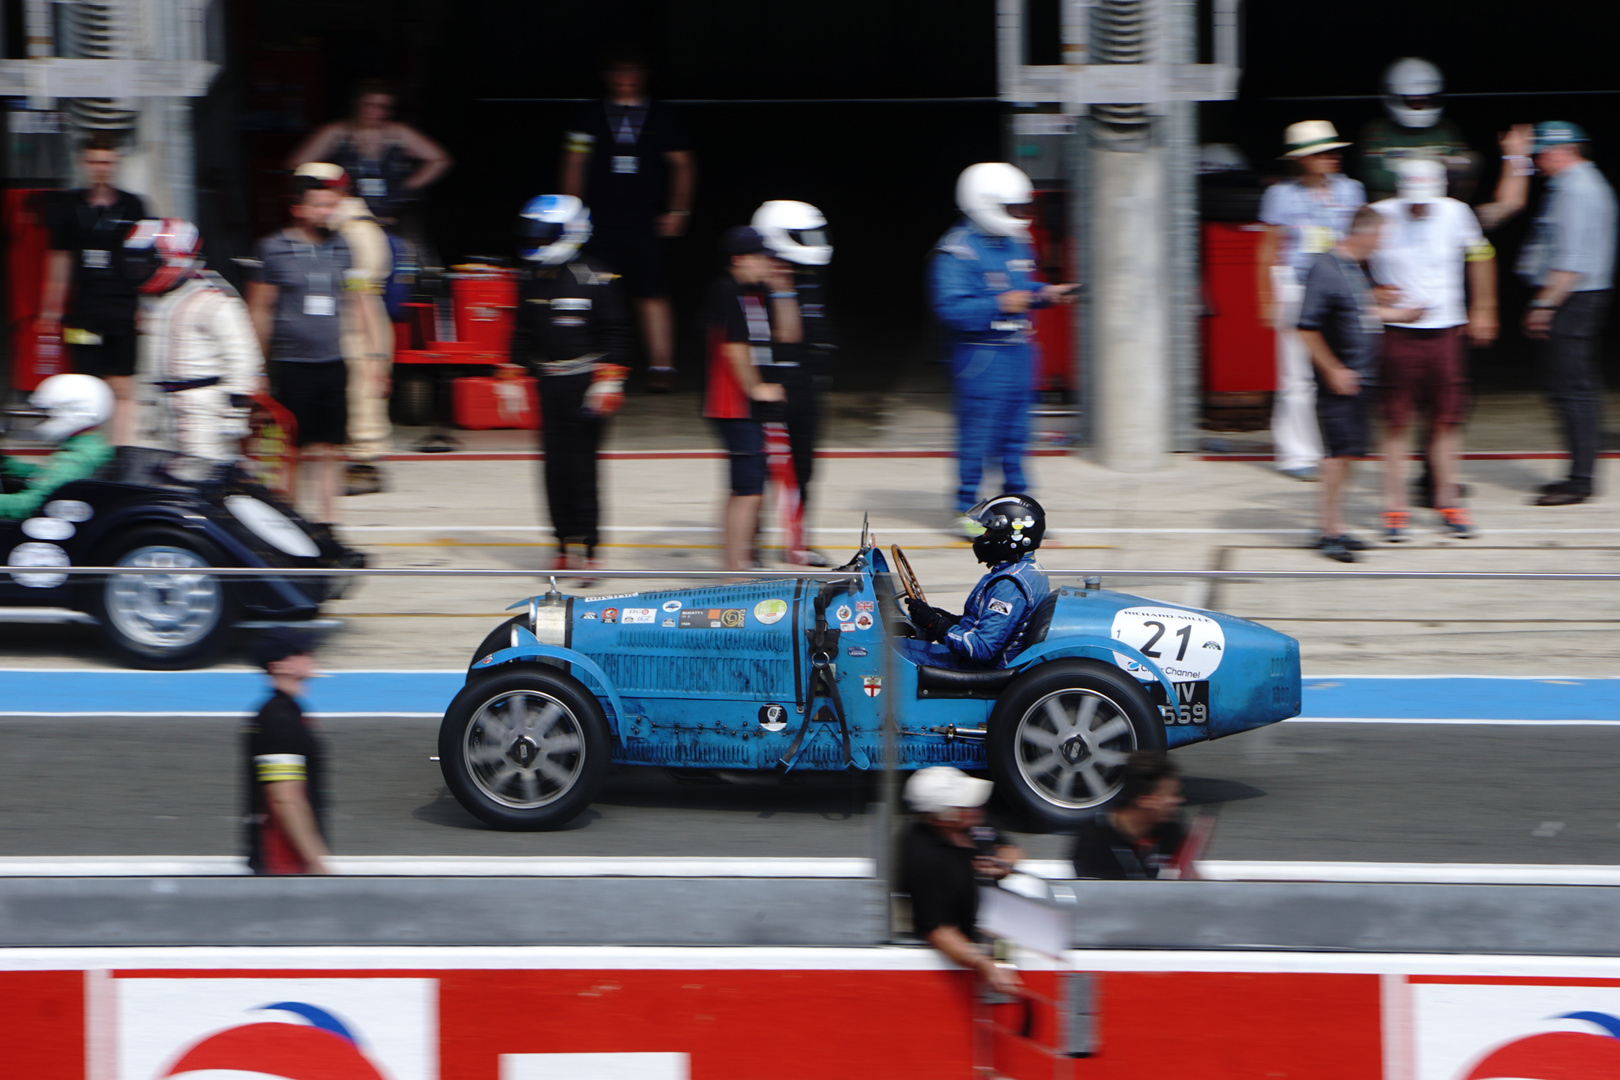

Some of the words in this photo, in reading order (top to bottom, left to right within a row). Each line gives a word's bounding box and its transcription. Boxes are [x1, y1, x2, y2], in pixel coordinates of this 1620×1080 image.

[1124, 611, 1174, 619] RICHARD
[1177, 615, 1212, 623] MILLE
[1116, 629, 1121, 638] 1
[1140, 620, 1192, 662] 21
[1165, 667, 1201, 678] Channel
